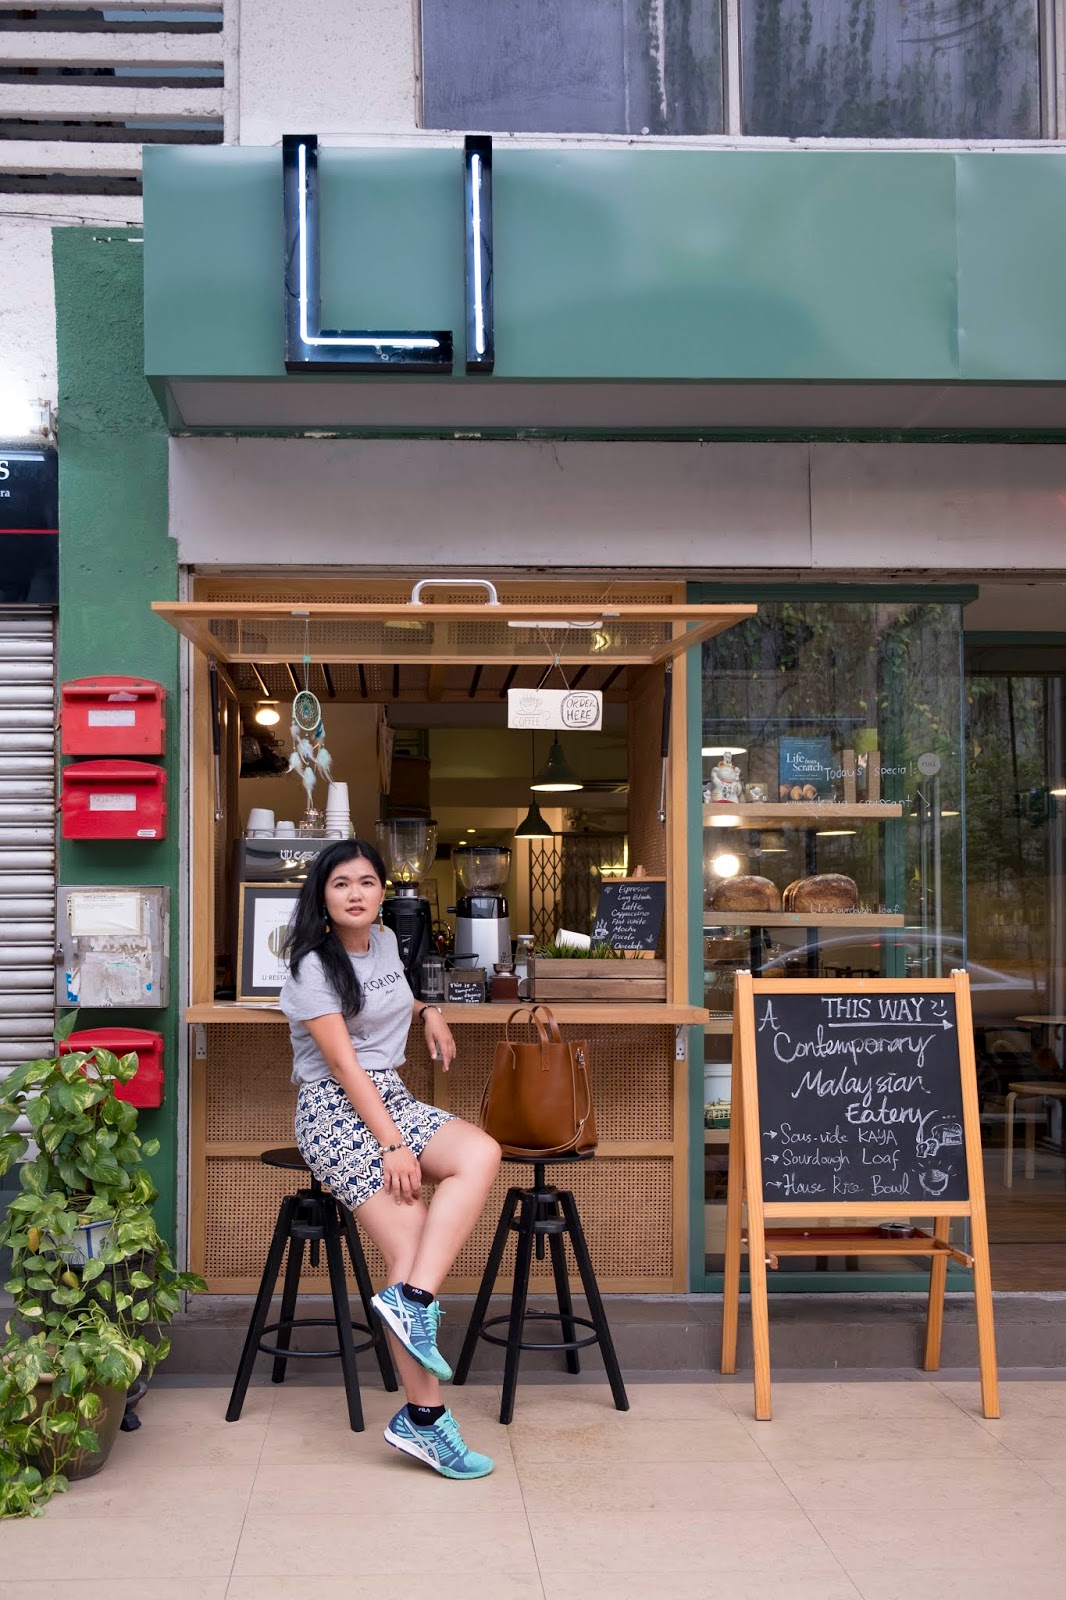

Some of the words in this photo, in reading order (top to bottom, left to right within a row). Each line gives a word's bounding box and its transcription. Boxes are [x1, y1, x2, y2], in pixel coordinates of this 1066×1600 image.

[282, 134, 494, 376] LI
[566, 698, 596, 708] ORDER
[512, 716, 540, 727] COFFEE
[566, 709, 592, 721] HERE
[786, 751, 805, 763] Life
[792, 762, 824, 772] Scratch
[618, 884, 650, 894] Espresso
[621, 902, 644, 911] Latte
[758, 1000, 780, 1031] A
[821, 997, 872, 1019] THIS
[879, 997, 925, 1022] WAY
[773, 1024, 937, 1067] Contemporary
[791, 1066, 931, 1107] Malaysian
[845, 1096, 939, 1144] Eatery
[780, 1122, 849, 1145] Sous-vide
[782, 1149, 850, 1172] Sourdough
[862, 1149, 901, 1171] Loaf
[783, 1173, 826, 1196] House
[833, 1175, 864, 1195] Rice
[871, 1173, 911, 1197] Bowl
